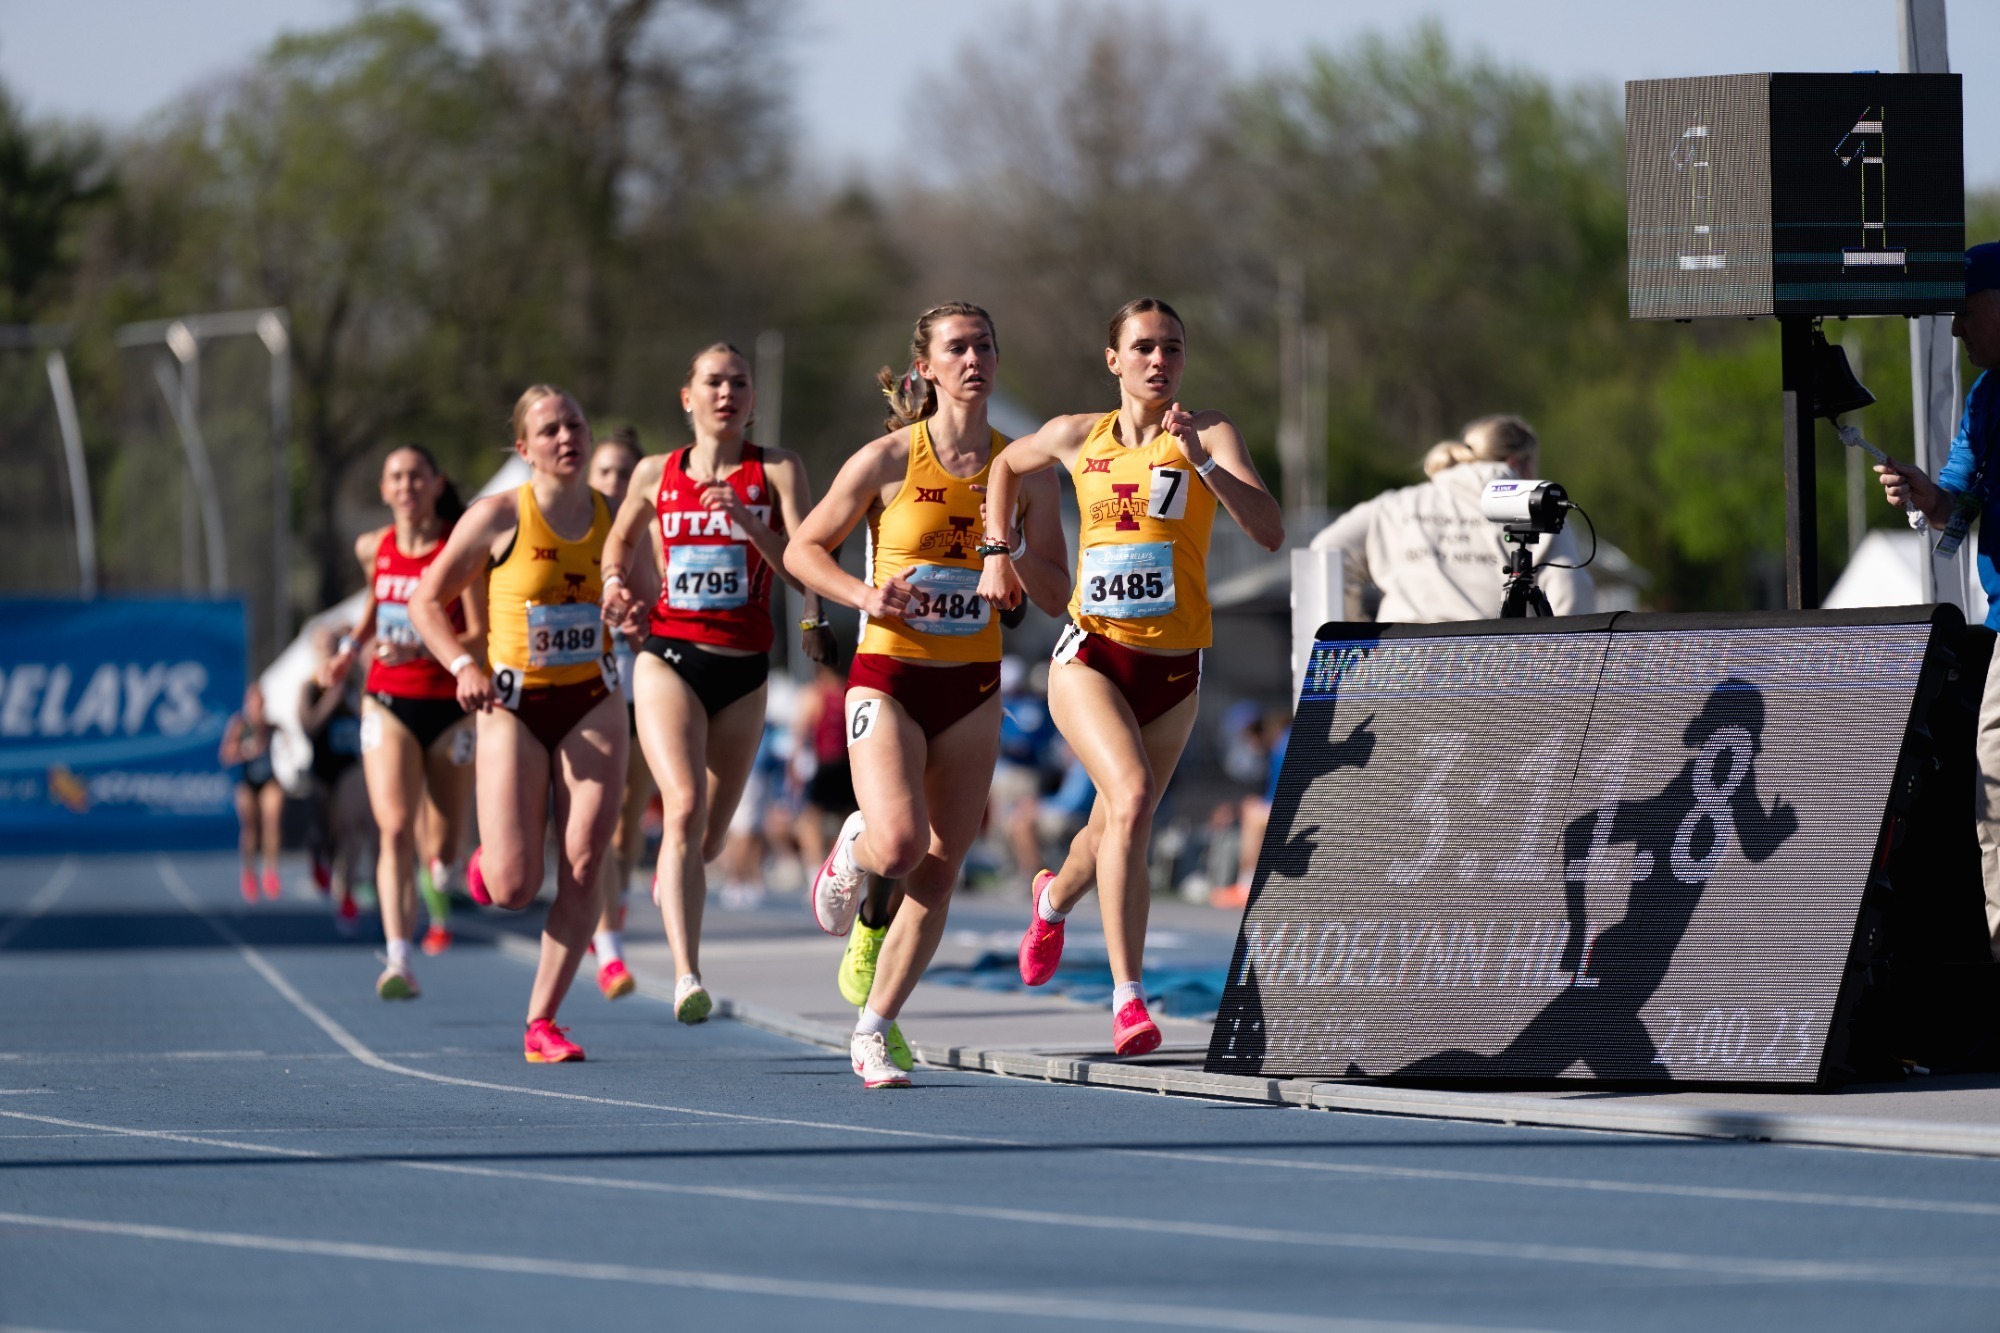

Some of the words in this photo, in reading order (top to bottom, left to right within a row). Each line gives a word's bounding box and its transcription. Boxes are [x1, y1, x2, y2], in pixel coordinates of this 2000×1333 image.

[1834, 106, 1907, 273] 1
[1082, 457, 1115, 474] XII
[914, 486, 948, 505] XII
[1158, 470, 1182, 515] 7
[662, 511, 732, 538] UTA
[1089, 498, 1152, 524] STAT
[920, 529, 983, 551] STAT
[375, 575, 420, 599] UTA
[675, 571, 739, 594] 4795
[1090, 572, 1164, 602] 3485
[914, 592, 982, 620] 3484
[536, 627, 595, 652] 3489
[0, 661, 209, 737] ELAYS
[497, 669, 514, 704] 9
[852, 701, 872, 739] 6
[1237, 920, 1497, 987] MADELYNN
[1499, 920, 1600, 988] HILL
